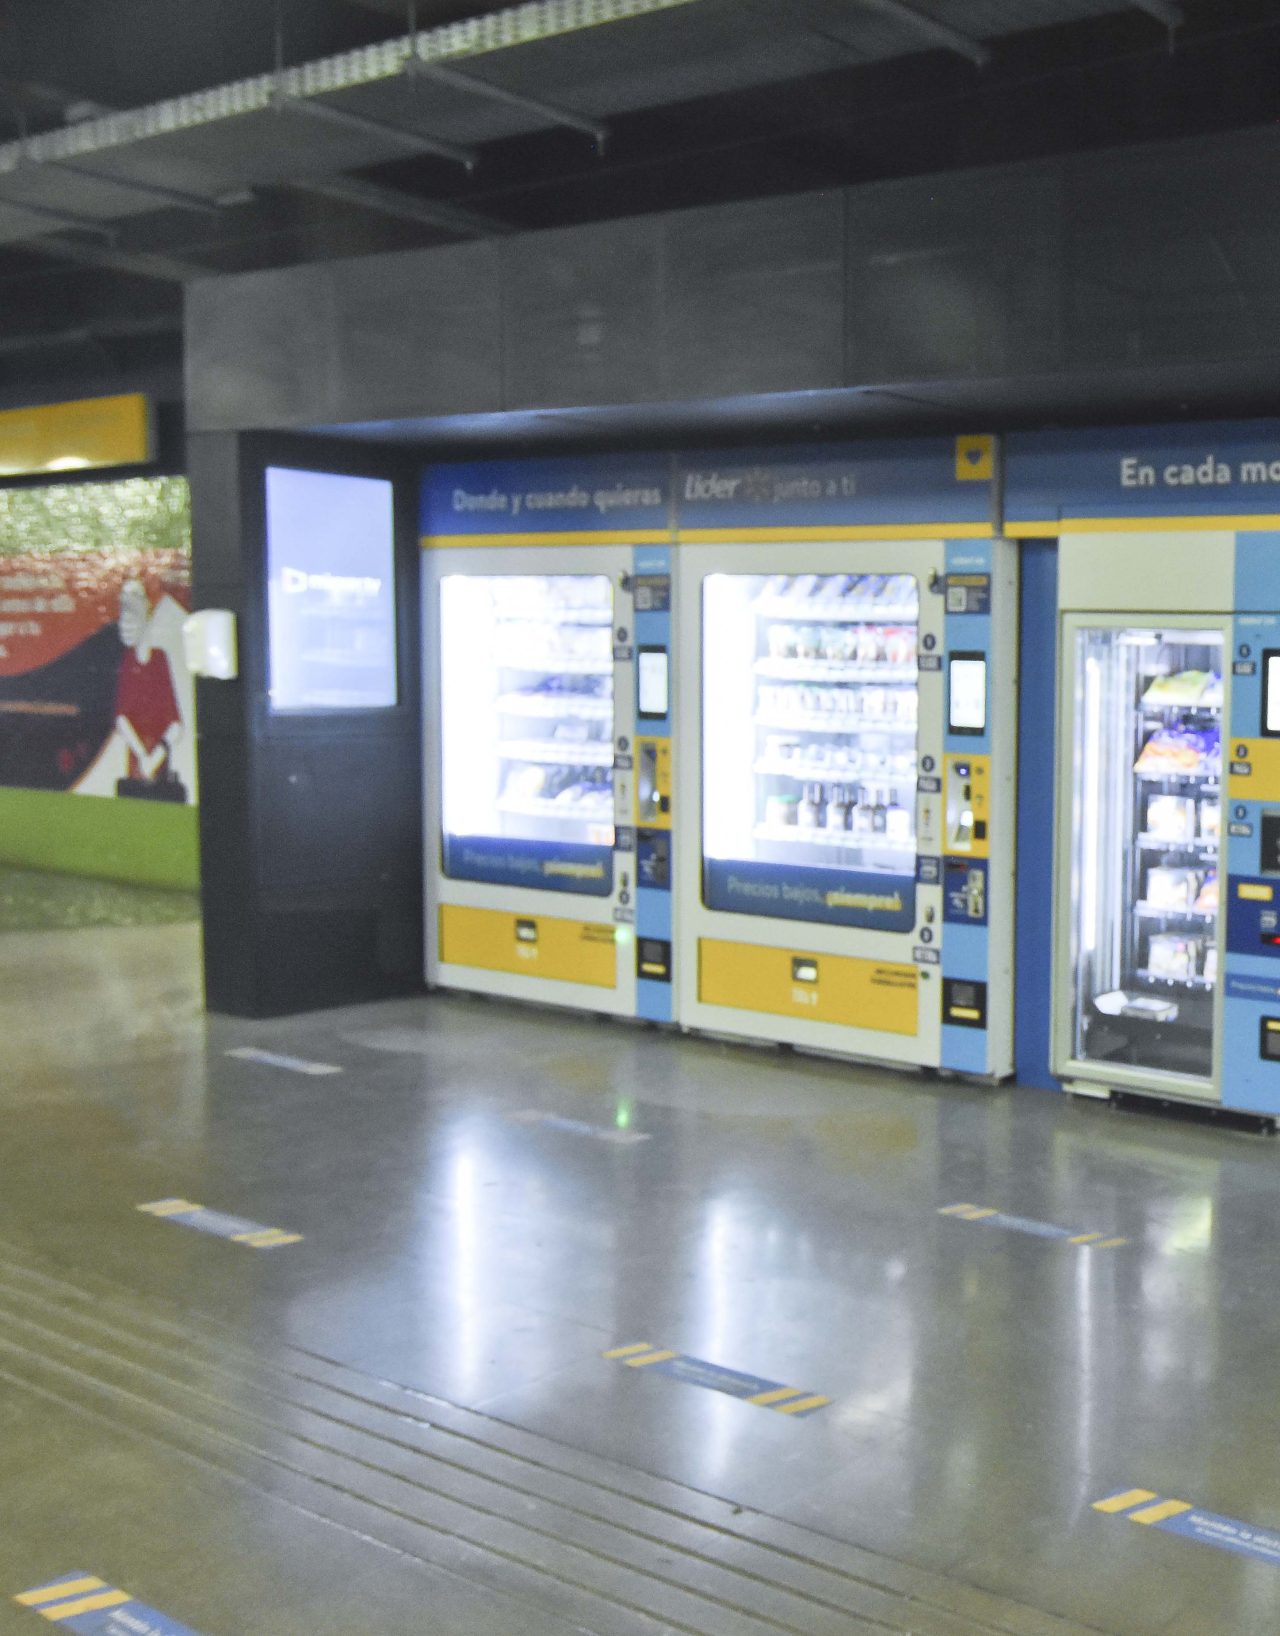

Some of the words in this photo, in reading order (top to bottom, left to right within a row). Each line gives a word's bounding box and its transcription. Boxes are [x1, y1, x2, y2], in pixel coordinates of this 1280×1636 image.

[1120, 456, 1155, 488] En
[1163, 454, 1232, 485] cada
[510, 491, 522, 516] y
[525, 485, 589, 510] cuando
[593, 483, 661, 514] quieras
[684, 473, 741, 501] Lider
[771, 475, 822, 503] junto
